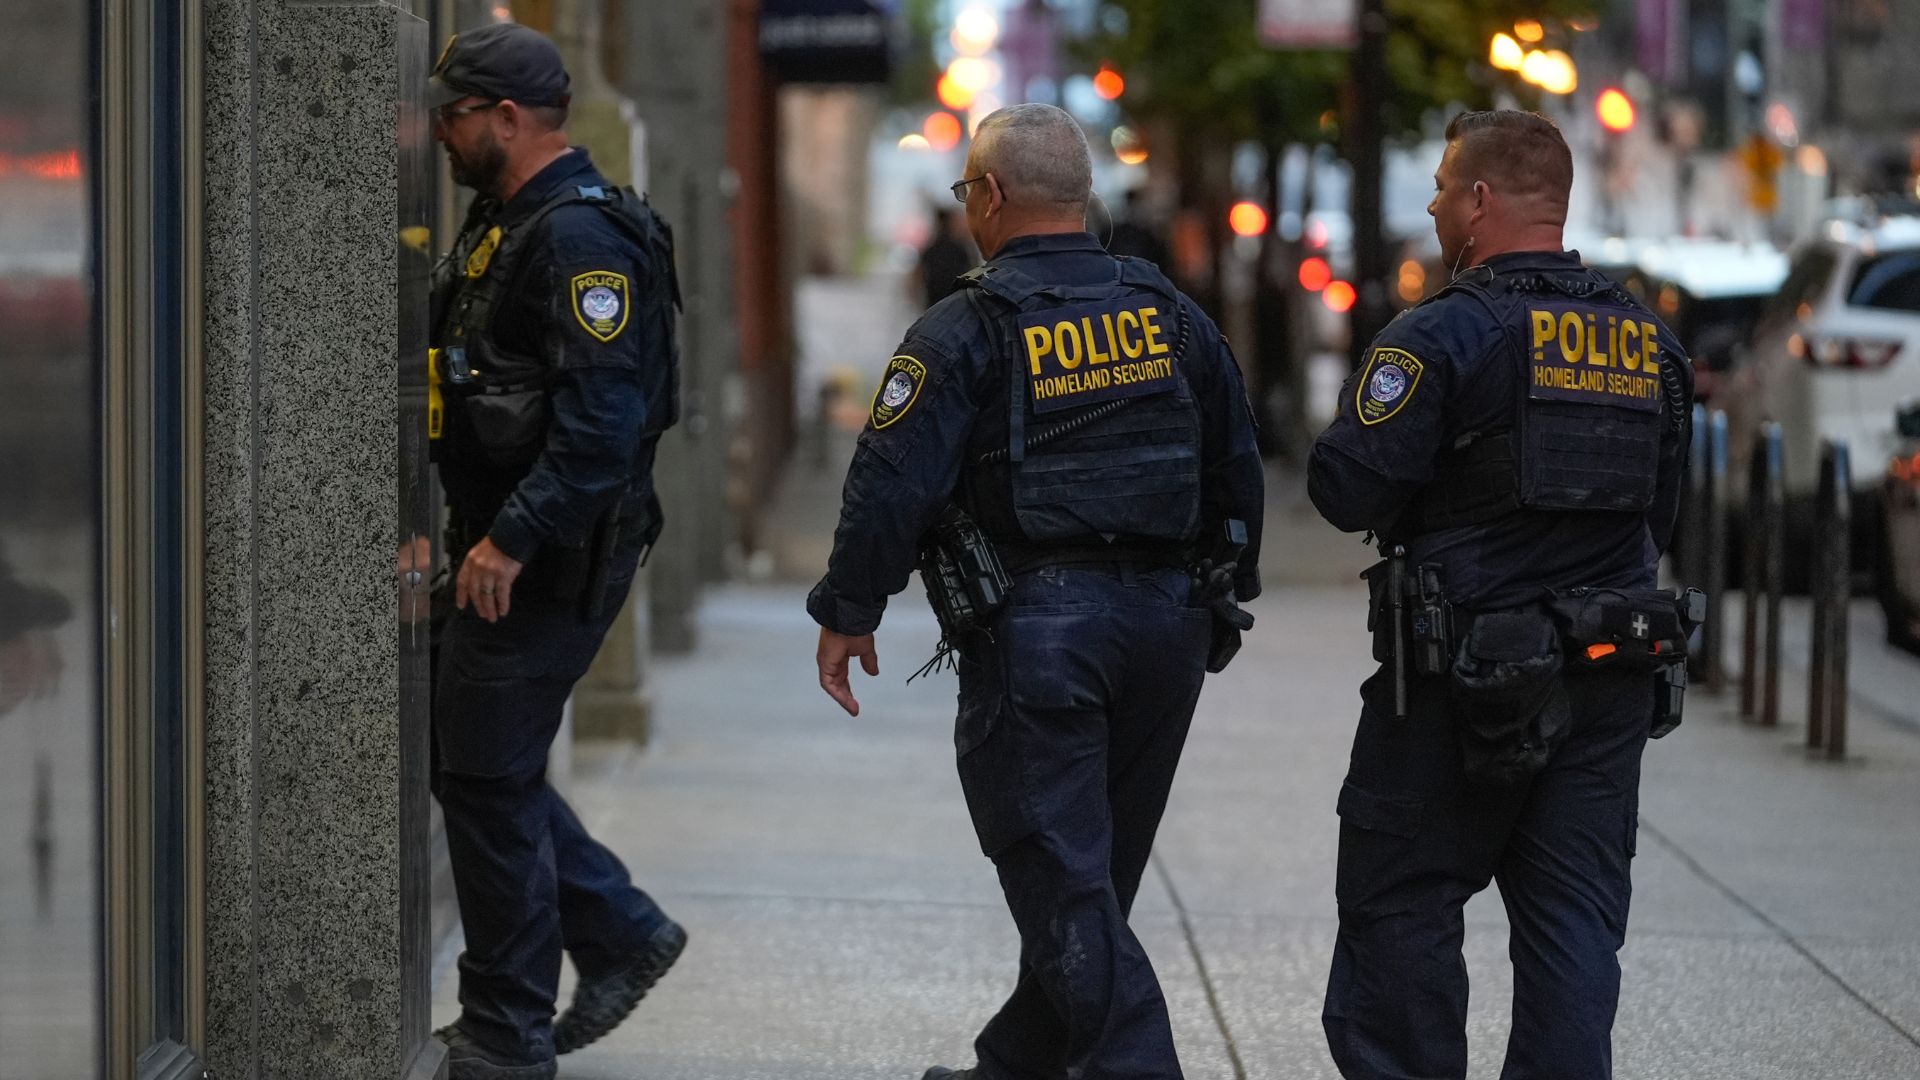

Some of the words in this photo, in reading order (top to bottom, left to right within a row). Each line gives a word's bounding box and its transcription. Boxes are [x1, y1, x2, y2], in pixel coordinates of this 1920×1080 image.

[577, 276, 622, 290] POLICE
[1024, 308, 1168, 375] POLICE
[1531, 310, 1659, 374] POLICE
[891, 360, 922, 380] POLICE
[1034, 368, 1111, 400] HOMELAND
[1113, 358, 1171, 385] SECURITY
[1378, 353, 1419, 375] POLICE
[1534, 365, 1604, 392] HOMELAND
[1607, 373, 1660, 400] SECURITY
